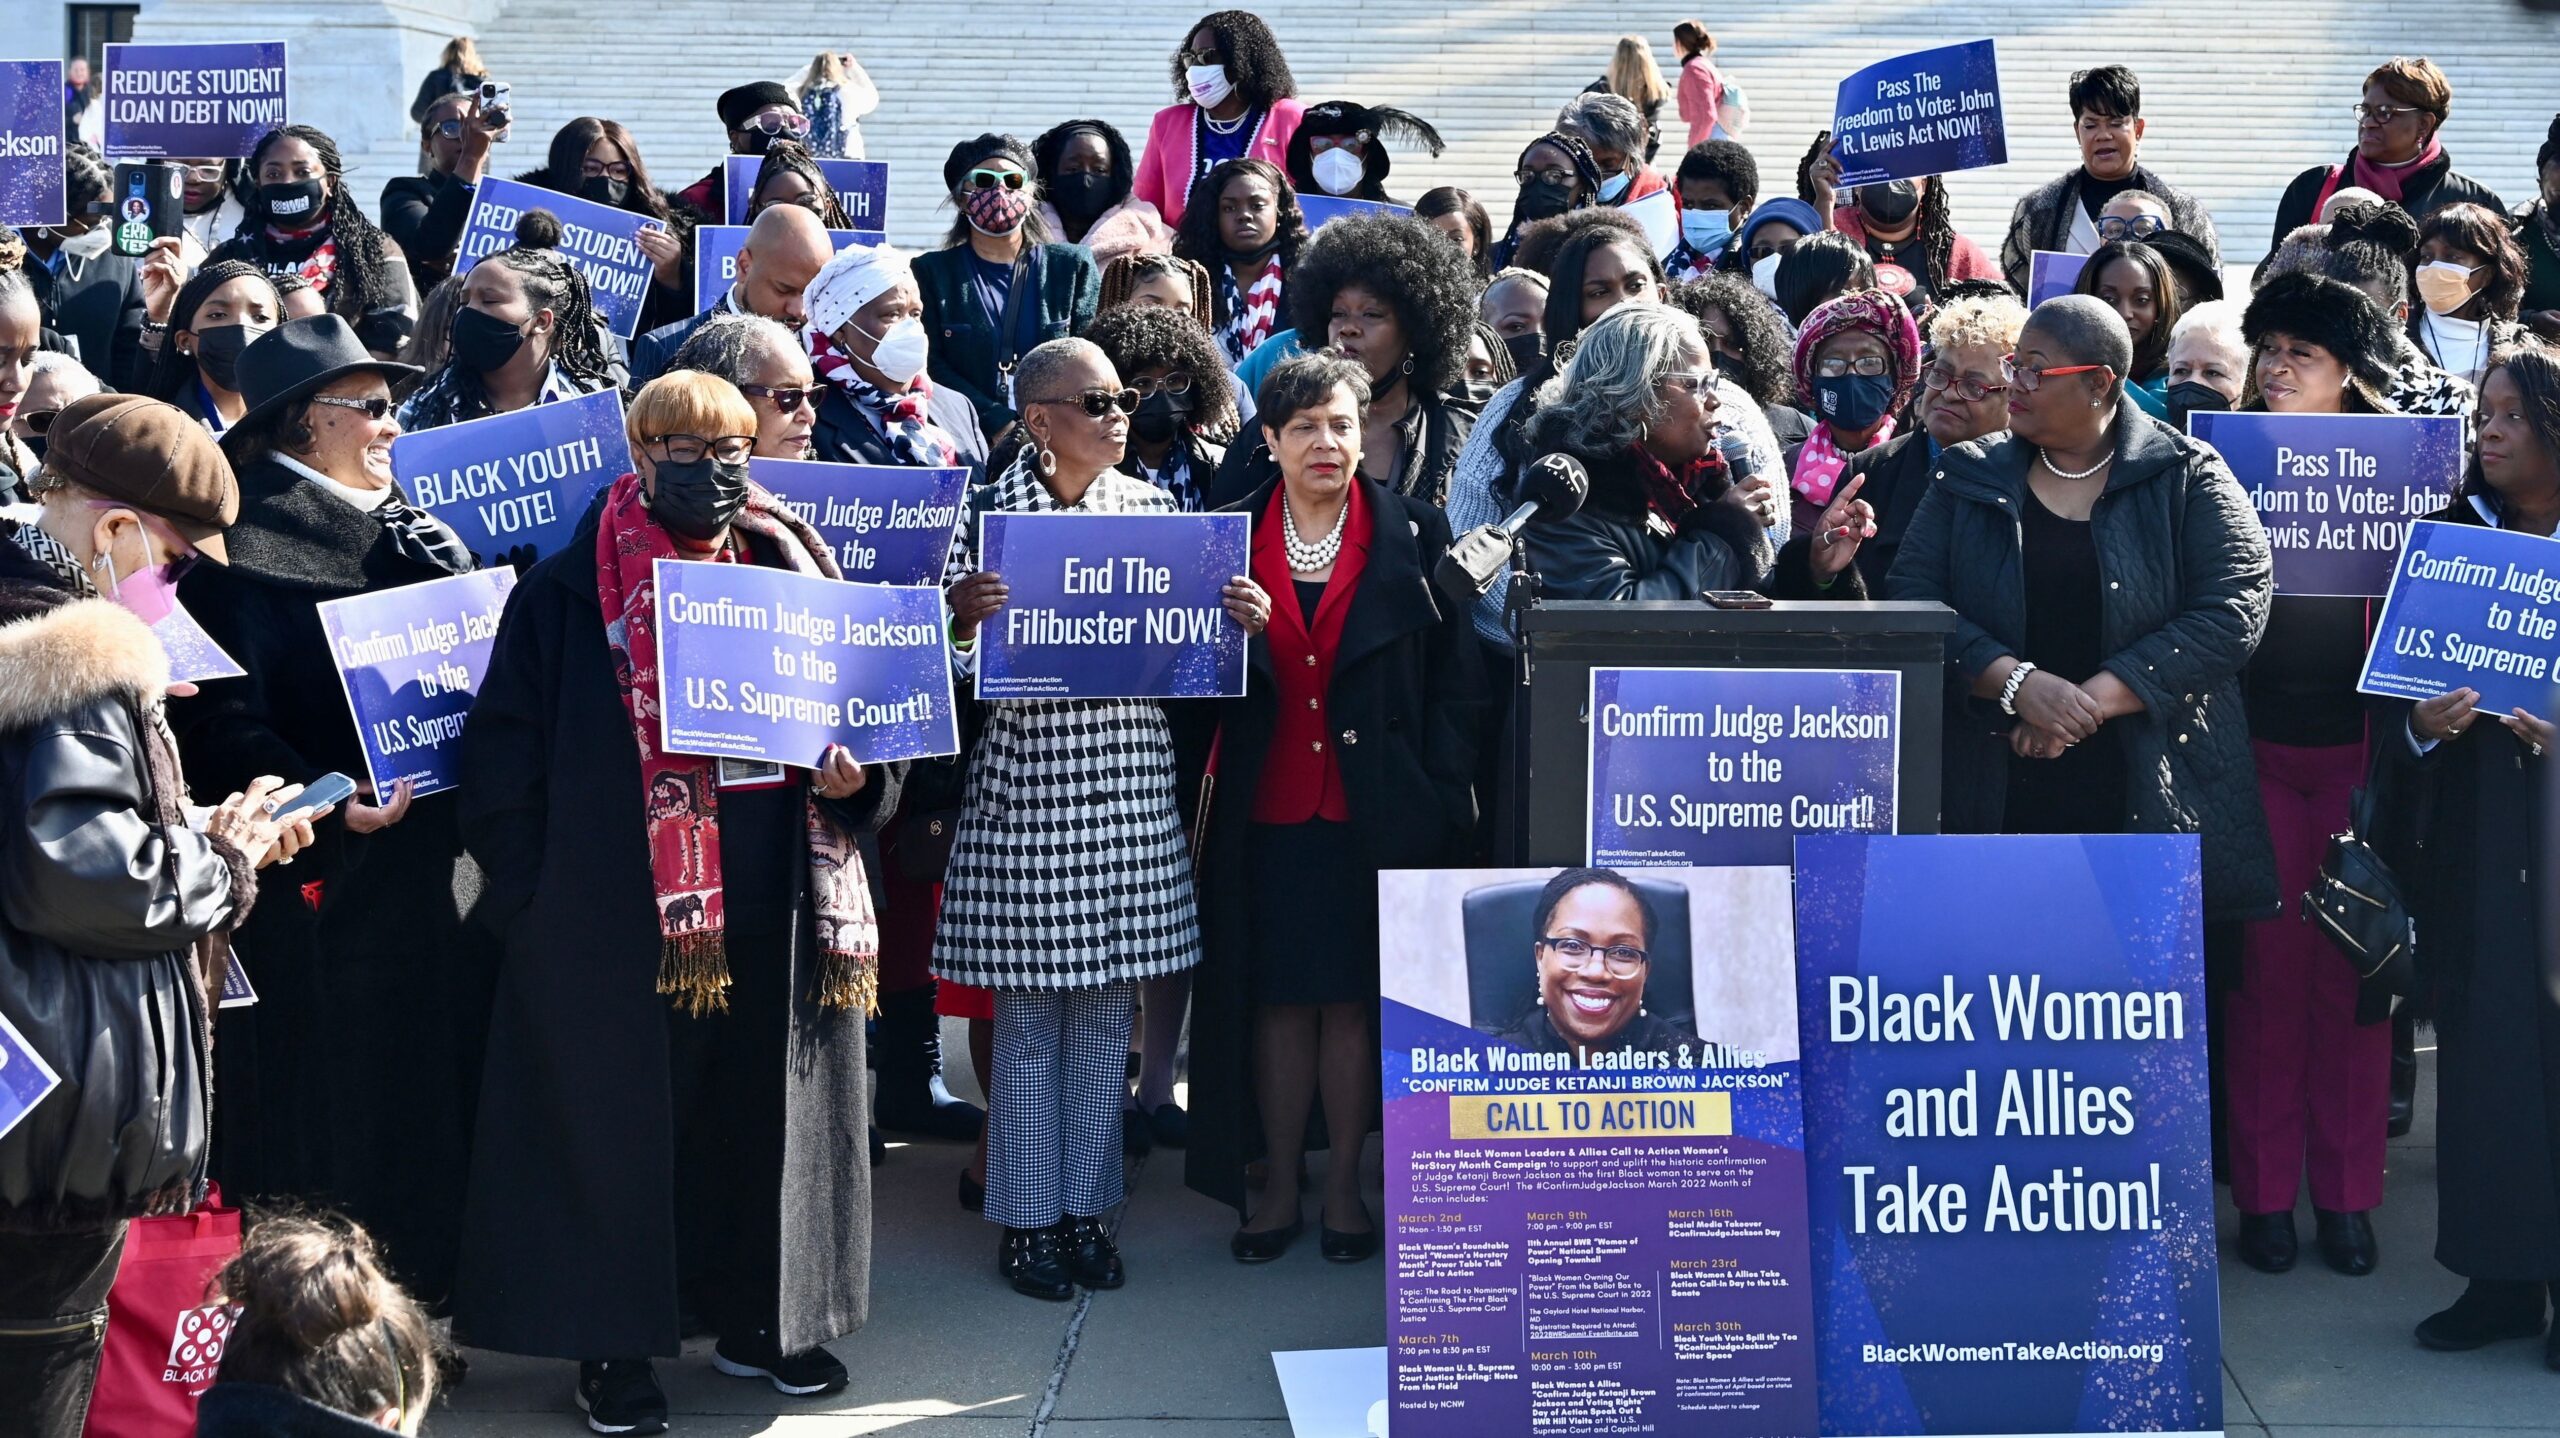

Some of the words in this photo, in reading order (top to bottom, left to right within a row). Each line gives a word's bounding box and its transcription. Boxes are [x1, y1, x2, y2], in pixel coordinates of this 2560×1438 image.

[111, 70, 192, 94] REDUCE
[197, 67, 282, 94] STUDENT
[1878, 79, 1910, 100] Pass
[1913, 72, 1941, 93] The
[110, 100, 164, 123] LOAN
[171, 100, 222, 124] DEBT
[227, 98, 284, 123] NOW!!
[1835, 107, 1893, 135] Freedom
[1897, 103, 1912, 121] to
[1916, 96, 1956, 118] Vote:
[1960, 89, 1994, 113] John
[0, 129, 57, 157] ckson
[1843, 135, 1858, 155] R.
[1861, 128, 1904, 152] Lewis
[1909, 123, 1934, 145] Act
[1937, 114, 1982, 141] NOW!
[840, 192, 869, 216] UTH
[120, 238, 149, 253] YES
[122, 222, 148, 239] ERA
[560, 223, 647, 269] STUDENT
[467, 232, 515, 258] LOA
[583, 260, 644, 300] NOW!!
[414, 460, 507, 509] BLACK
[507, 437, 602, 487] YOUTH
[2277, 447, 2329, 477] Pass
[2336, 448, 2376, 477] The
[478, 490, 556, 536] VOTE!
[2306, 486, 2328, 513] to
[2336, 484, 2394, 515] Vote:
[821, 496, 882, 534] Judge
[886, 499, 955, 529] Jackson
[2263, 521, 2309, 549] ewis
[2316, 521, 2355, 550] Act
[2363, 521, 2408, 551] NO
[843, 539, 876, 570] the
[2407, 550, 2496, 588] Confirm
[1064, 557, 1113, 594] End
[1122, 557, 1170, 594] The
[668, 592, 767, 630] Confirm
[773, 602, 835, 646] Judge
[842, 614, 936, 646] Jackson
[1008, 608, 1137, 645] Filibuster
[1145, 607, 1222, 644] NOW!
[2487, 602, 2512, 631] to
[2518, 608, 2556, 640] the
[338, 630, 408, 668] Confirm
[408, 618, 459, 655] Judge
[461, 606, 503, 643] Jack
[773, 646, 795, 677] to
[801, 650, 837, 684] the
[2395, 626, 2435, 658] U.S.
[2442, 633, 2546, 679] Supreme
[417, 668, 438, 698] to
[438, 661, 470, 693] the
[2370, 671, 2447, 687] #BlackWomenTakeAction
[686, 677, 733, 711] U.S.
[740, 682, 840, 727] Supreme
[848, 693, 932, 728] Court!!
[373, 719, 410, 756] U.S.
[407, 711, 468, 750] Suprem
[671, 729, 757, 742] #BlackWomenTakeAction
[1602, 703, 1704, 737] Confirm
[1711, 704, 1783, 744] Judge
[1789, 706, 1888, 739] Jackson
[672, 738, 765, 753] BlackWomenTakeAction.org
[1708, 752, 1733, 782] to
[1741, 750, 1781, 783] the
[1614, 794, 1662, 827] U.S.
[1670, 795, 1782, 834] Supreme
[1790, 795, 1873, 829] Court!!
[1596, 859, 1693, 867] BlackWomenTakeAction.org
[1829, 975, 1975, 1043] Black
[1989, 973, 2184, 1041] Women
[1411, 1047, 1479, 1073] Black
[1487, 1046, 1570, 1072] Women
[1579, 1045, 1670, 1071] Leaders
[1677, 1044, 1693, 1070] &
[1702, 1044, 1766, 1069] Allies
[1494, 1078, 1550, 1091] JUDGE
[1556, 1076, 1626, 1090] KETANJI
[1632, 1075, 1695, 1089] BROWN
[1487, 1102, 1549, 1131] CALL
[1558, 1101, 1590, 1130] TO
[1601, 1100, 1695, 1130] ACTION
[1886, 1070, 1978, 1138] and
[1995, 1068, 2135, 1136] Allies
[1411, 1150, 1431, 1159] Join
[1435, 1149, 1450, 1158] the
[1454, 1149, 1481, 1157] Black
[1484, 1149, 1521, 1157] Women
[1525, 1147, 1565, 1156] Leaders
[1568, 1148, 1575, 1156] &
[1579, 1147, 1607, 1156] Allies
[1610, 1146, 1630, 1155] Call
[1411, 1161, 1456, 1172] HerStory
[1459, 1160, 1490, 1169] Month
[1494, 1160, 1546, 1171] Campaign
[1563, 1160, 1598, 1170] support
[1602, 1158, 1619, 1166] and
[1623, 1157, 1647, 1168] uplift
[1669, 1157, 1703, 1165] historic
[1707, 1156, 1766, 1164] confirmation
[1411, 1172, 1421, 1181] of
[1425, 1170, 1453, 1182] Judge
[1456, 1171, 1488, 1182] Ketanji
[1492, 1170, 1520, 1179] Brown
[1524, 1169, 1561, 1178] Jackson
[1578, 1169, 1593, 1177] the
[1596, 1169, 1614, 1177] first
[1618, 1168, 1643, 1177] Black
[1738, 1167, 1753, 1175] the
[1412, 1183, 1431, 1192] U.S.
[1434, 1181, 1476, 1193] Supreme
[1479, 1180, 1509, 1190] Court!
[1516, 1181, 1532, 1190] The
[1536, 1180, 1644, 1191] #ConfirmJudgeJackson
[1648, 1179, 1677, 1187] March
[1681, 1179, 1705, 1187] 2022
[1709, 1178, 1738, 1186] Month
[1742, 1178, 1750, 1186] of
[1412, 1195, 1442, 1203] Action
[1446, 1192, 1488, 1202] includes:
[1668, 1209, 1704, 1217] March
[1709, 1208, 1732, 1217] 16th
[1843, 1166, 1967, 1234] Take
[1984, 1163, 2163, 1233] Action!
[1398, 1213, 1435, 1222] March
[1440, 1213, 1460, 1221] 2nd
[1527, 1211, 1563, 1220] March
[1568, 1211, 1586, 1219] 9th
[1670, 1259, 1706, 1268] March
[1712, 1259, 1736, 1267] 23rd
[1399, 1334, 1435, 1343] March
[1440, 1334, 1458, 1342] 7th
[1674, 1322, 1710, 1331] March
[1715, 1322, 1741, 1330] 30th
[1531, 1351, 1567, 1359] March
[1573, 1350, 1596, 1359] 10th
[1863, 1342, 2164, 1363] BlackWomenTakeAction.org
[162, 1368, 206, 1383] BLACK
